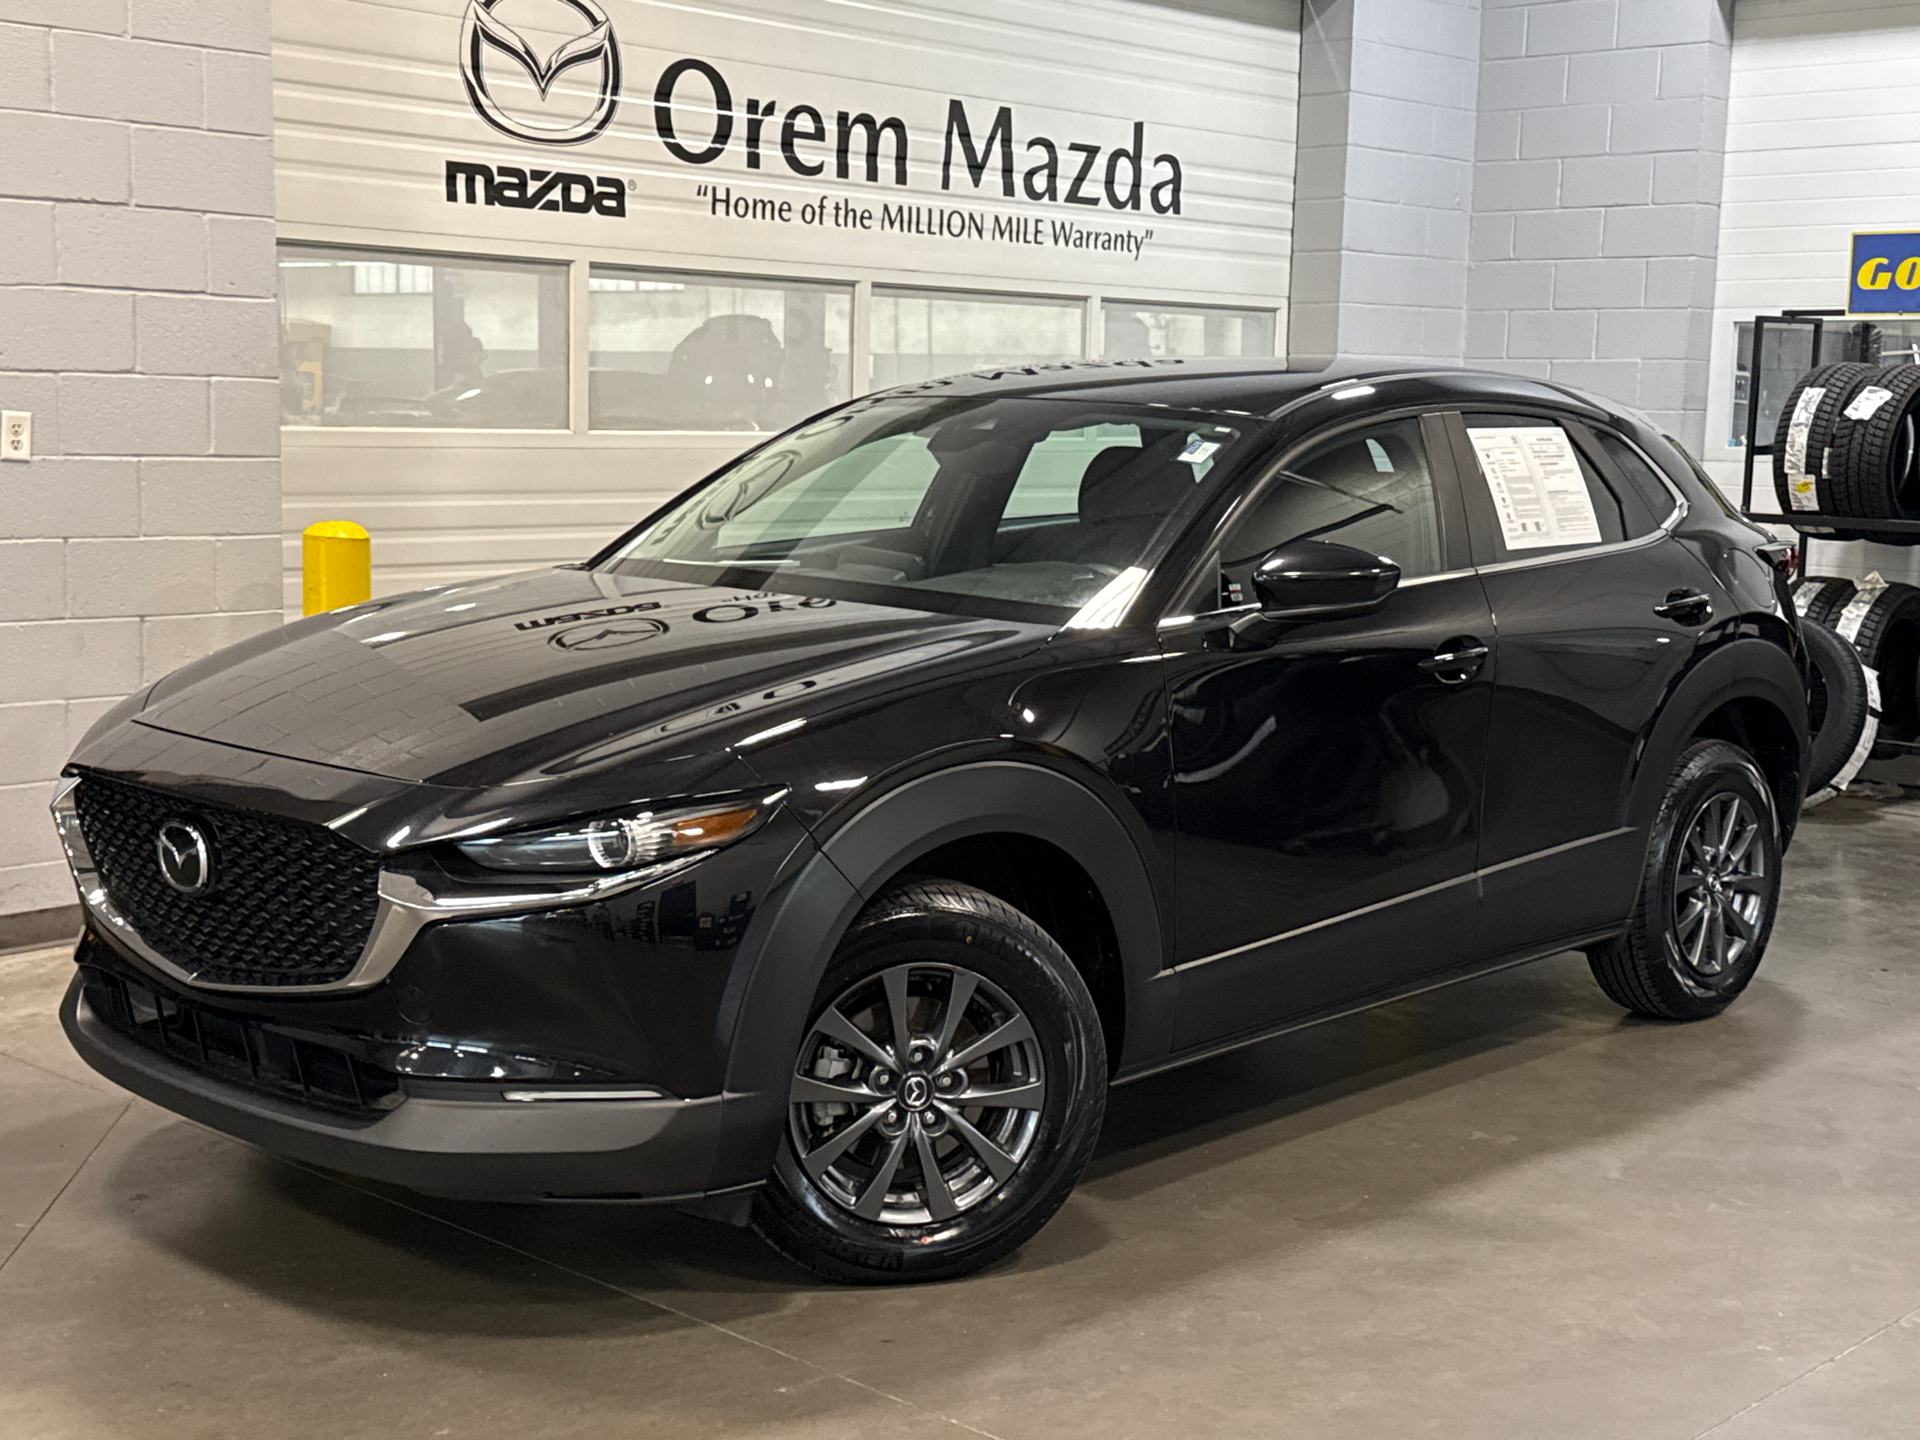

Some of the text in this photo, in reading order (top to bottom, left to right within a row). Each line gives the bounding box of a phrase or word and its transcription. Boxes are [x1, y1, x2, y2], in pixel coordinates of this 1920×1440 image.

[653, 58, 1182, 216] Orem Mazda
[445, 160, 627, 218] mazda
[801, 195, 829, 226] of
[833, 198, 873, 230] the
[881, 203, 984, 240] MILLION
[991, 214, 1045, 246] MILE
